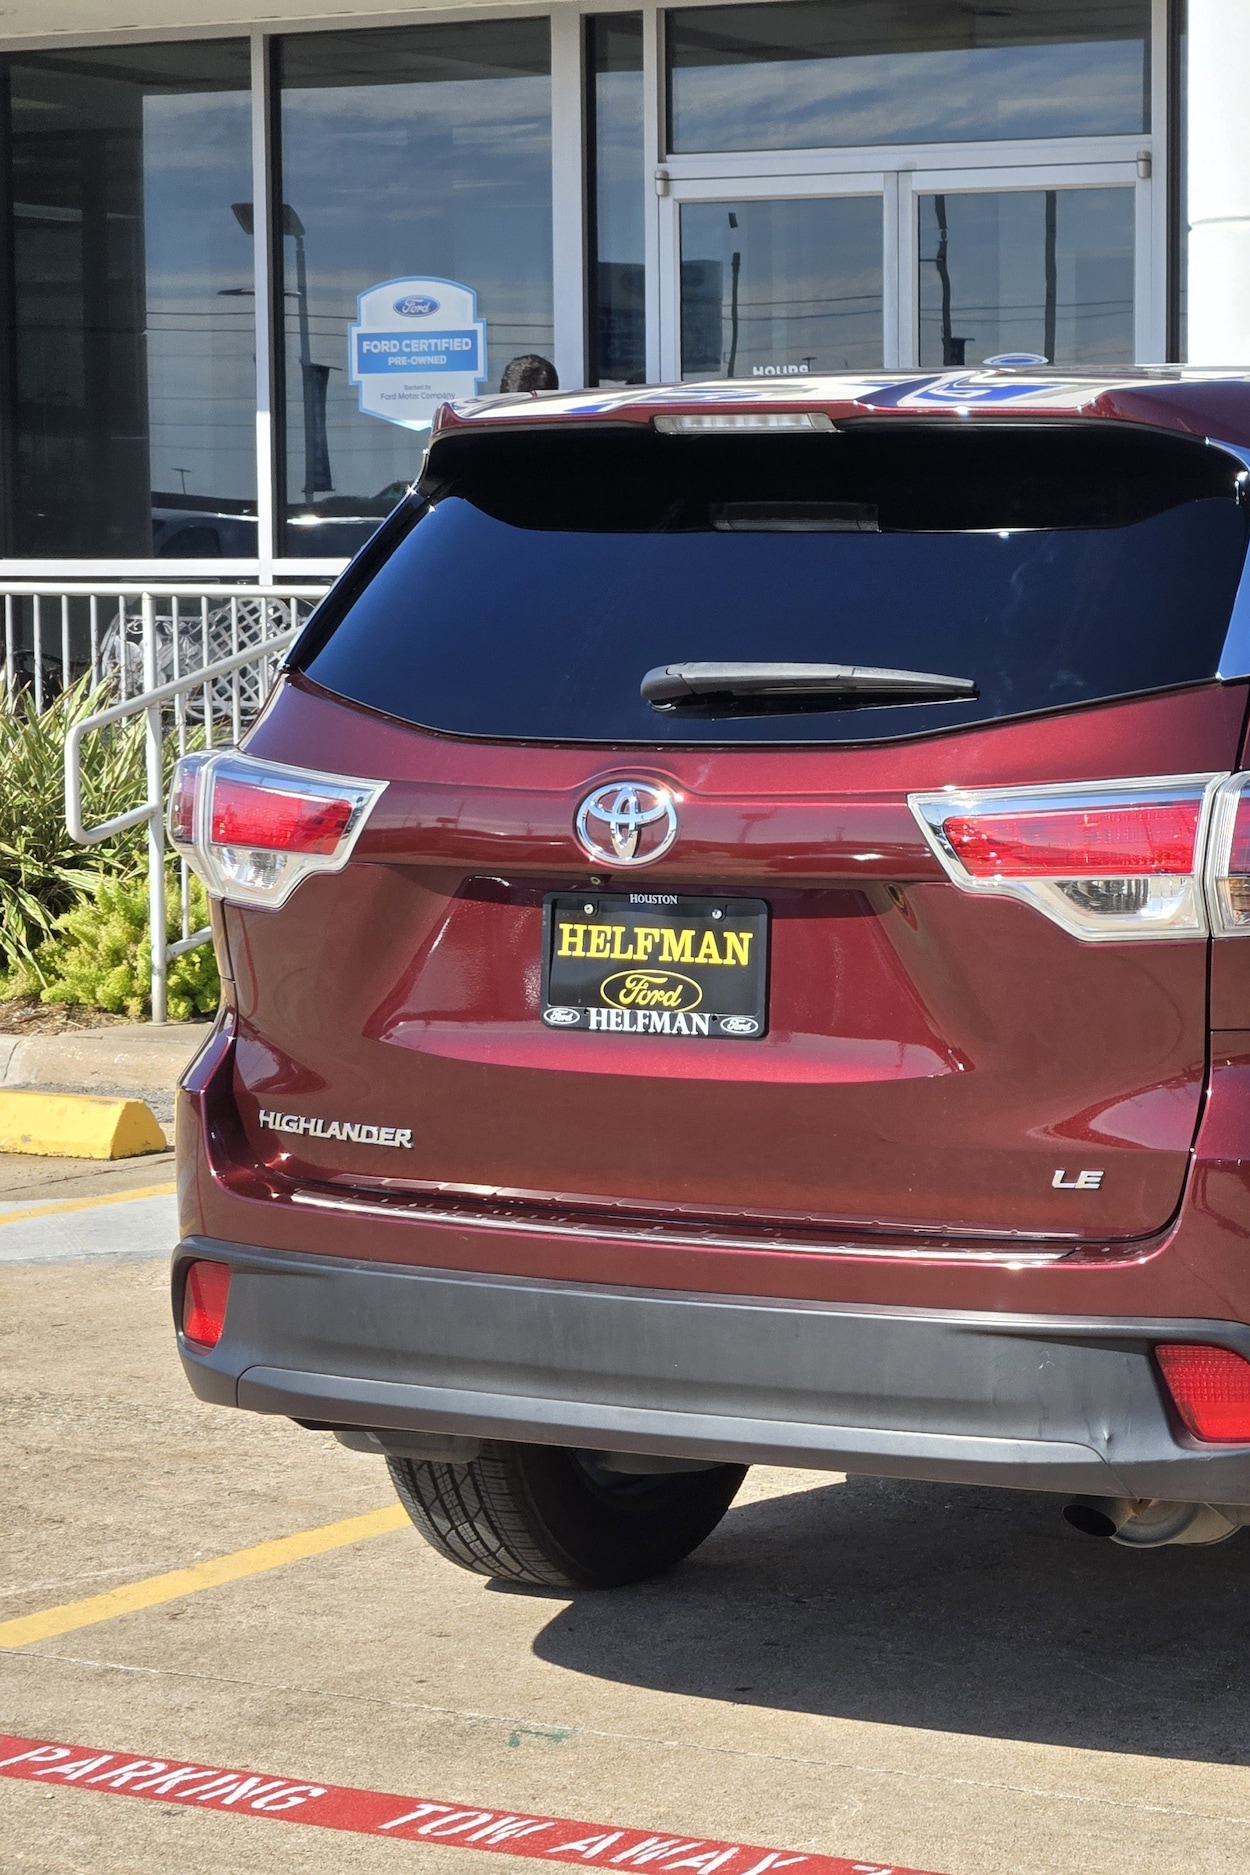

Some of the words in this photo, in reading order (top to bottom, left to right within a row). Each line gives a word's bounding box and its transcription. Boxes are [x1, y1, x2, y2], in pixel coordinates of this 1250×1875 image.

[402, 299, 431, 314] Ford
[362, 340, 400, 353] FORD
[401, 337, 472, 352] CERTIFIED
[387, 355, 448, 366] PRE-OWNED
[380, 392, 397, 401] Ford
[398, 391, 420, 400] Motor
[420, 390, 456, 401] Company
[629, 893, 679, 905] HOUSTON
[557, 923, 753, 966] HELFMAN
[619, 974, 684, 1007] Ford
[588, 1007, 711, 1036] HELFMAN
[258, 1109, 414, 1149] HIGHLANDER
[1051, 1169, 1104, 1189] LE
[0, 1745, 328, 1811] PARKING
[377, 1803, 556, 1844] TOW
[546, 1831, 808, 1875] AWAY
